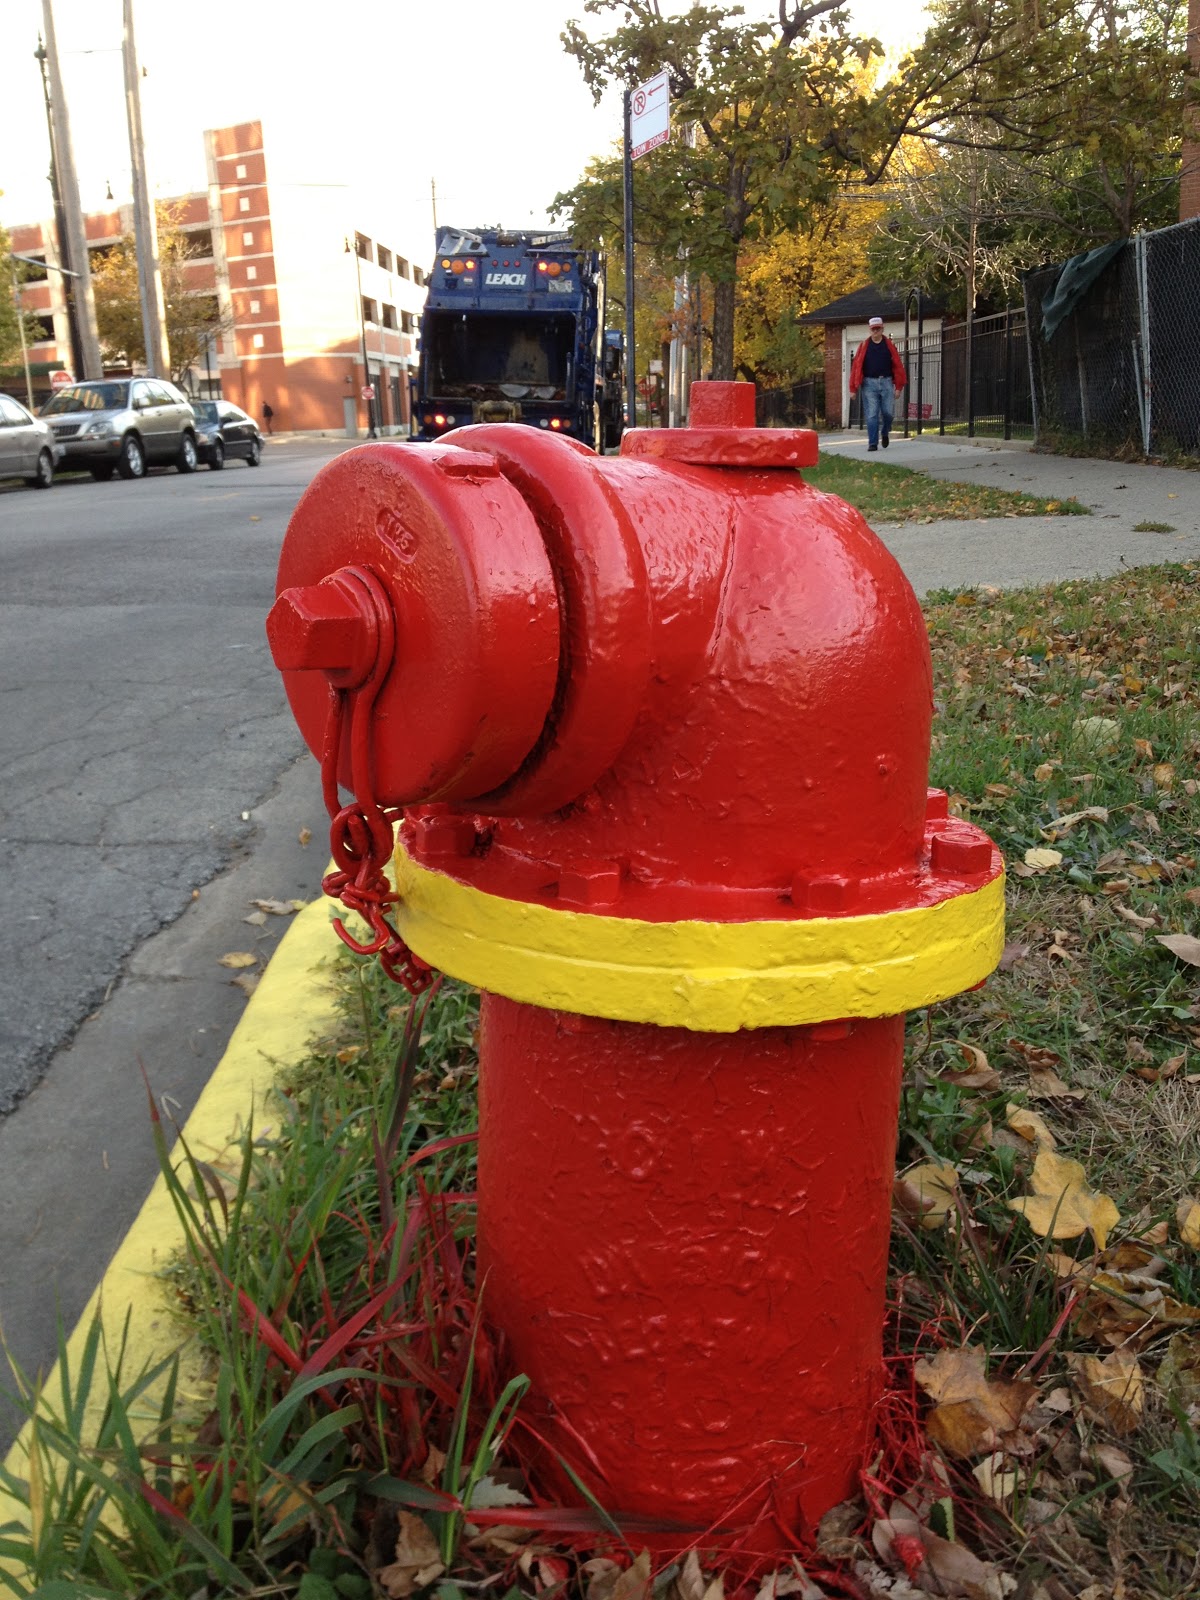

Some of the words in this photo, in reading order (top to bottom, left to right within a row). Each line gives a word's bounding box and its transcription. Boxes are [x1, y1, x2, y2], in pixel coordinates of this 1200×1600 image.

[633, 143, 646, 157] TOW
[649, 132, 665, 148] ZONE
[485, 273, 527, 286] LEACH
